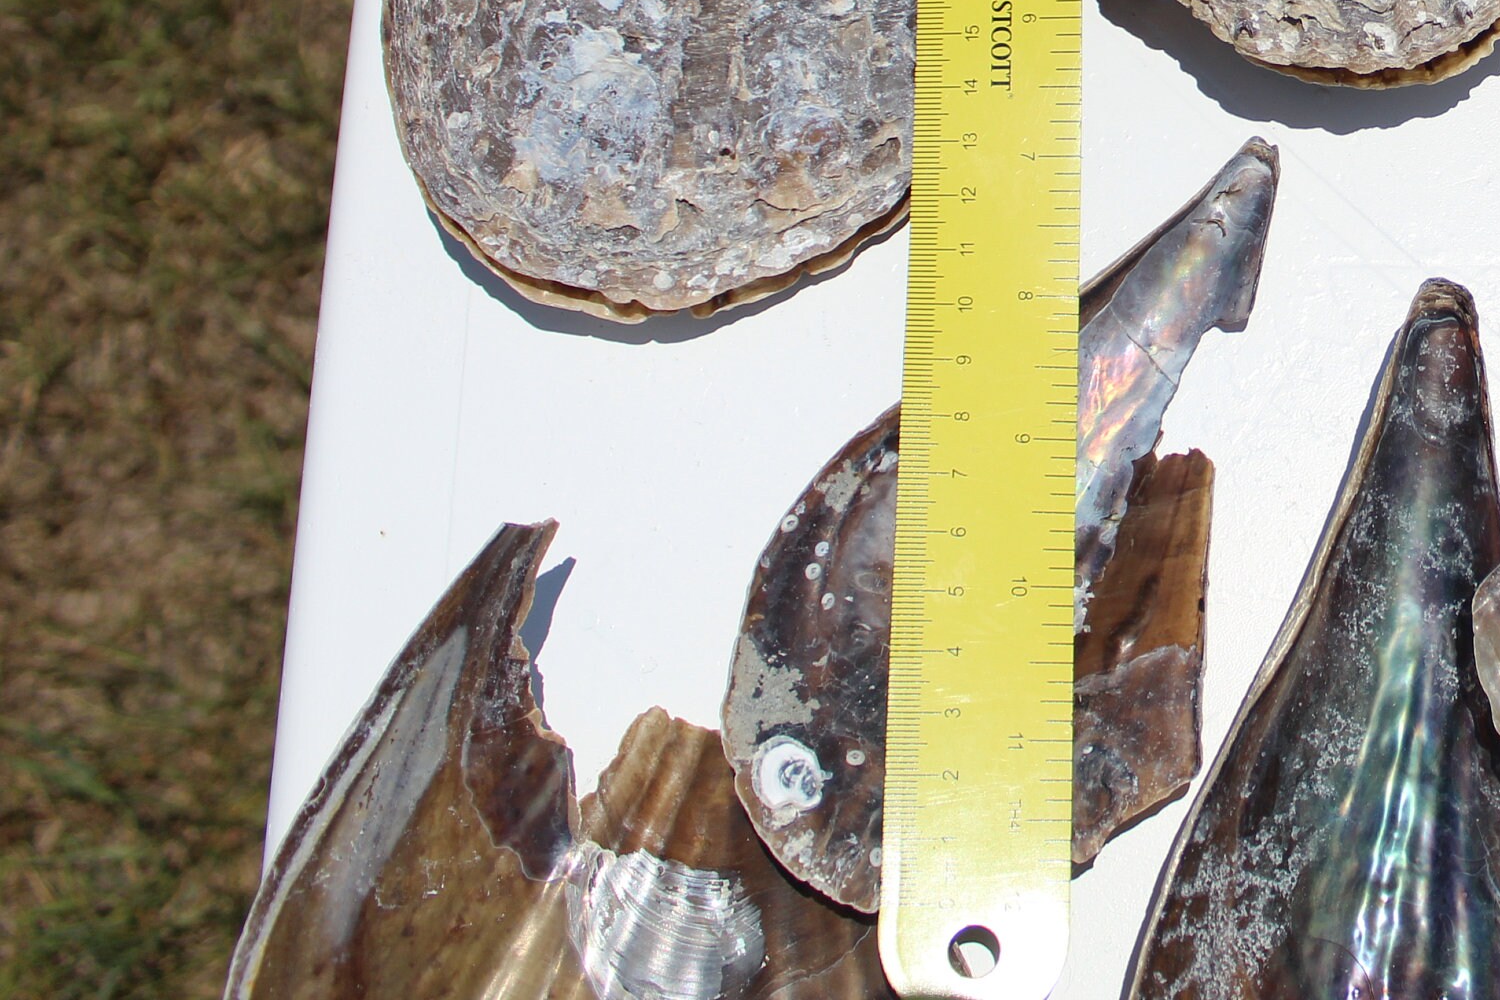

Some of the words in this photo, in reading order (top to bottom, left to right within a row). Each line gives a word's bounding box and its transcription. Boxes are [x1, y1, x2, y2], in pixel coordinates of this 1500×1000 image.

[1022, 13, 1037, 23] 6
[965, 25, 980, 41] 15
[964, 78, 978, 95] 14
[962, 132, 978, 150] 13
[1020, 151, 1035, 161] 7
[961, 187, 977, 204] 12
[960, 242, 975, 256] 11
[1018, 291, 1033, 300] 8
[958, 296, 973, 313] 10
[956, 355, 971, 365] 9
[954, 411, 970, 421] 8
[1015, 433, 1031, 444] 9
[952, 468, 968, 478] 7
[950, 527, 967, 537] 6
[949, 586, 964, 597] 5
[1011, 576, 1027, 597] 10
[947, 646, 962, 657] 4
[944, 707, 961, 718] 3
[1008, 732, 1024, 750] 11
[942, 770, 959, 780] 2
